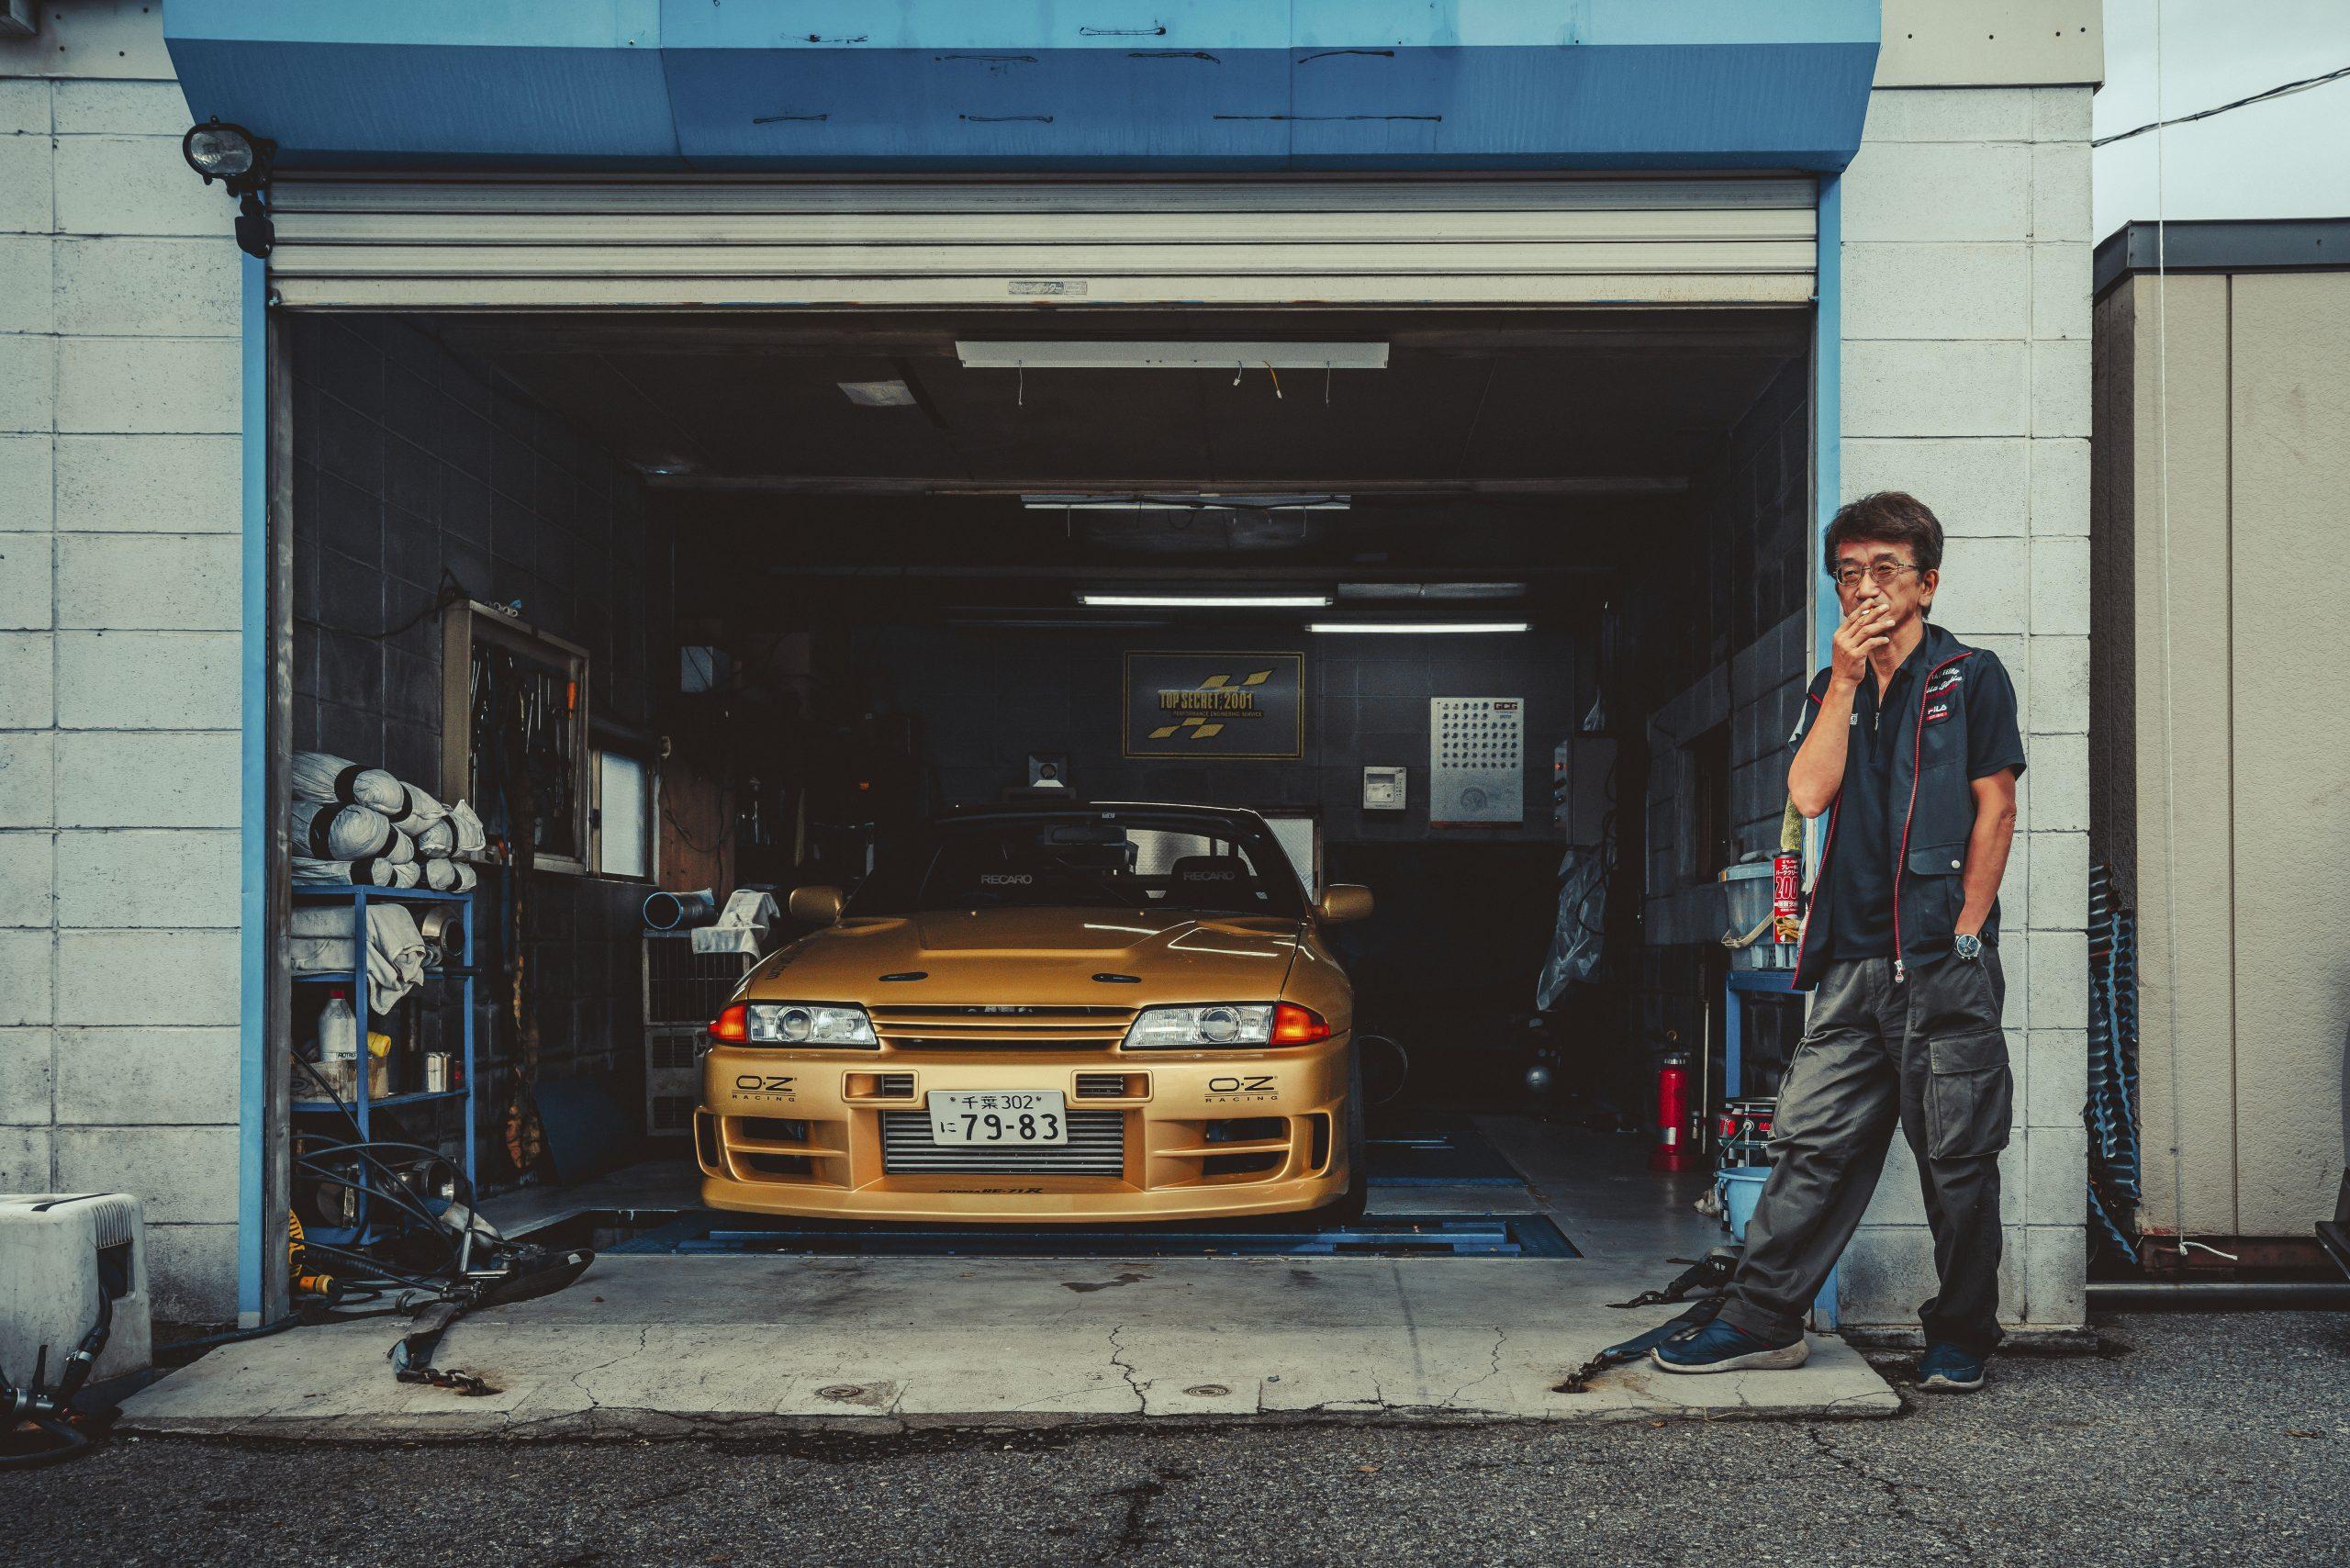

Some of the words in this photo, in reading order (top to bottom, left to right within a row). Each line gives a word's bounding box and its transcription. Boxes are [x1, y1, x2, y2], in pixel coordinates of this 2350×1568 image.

[1160, 692, 1180, 709] TOP
[1494, 702, 1518, 711] GCG
[1927, 704, 1948, 715] FILA
[980, 873, 1034, 885] RECARO
[1182, 870, 1236, 882] RECARO
[960, 1113, 1059, 1141] 79-83
